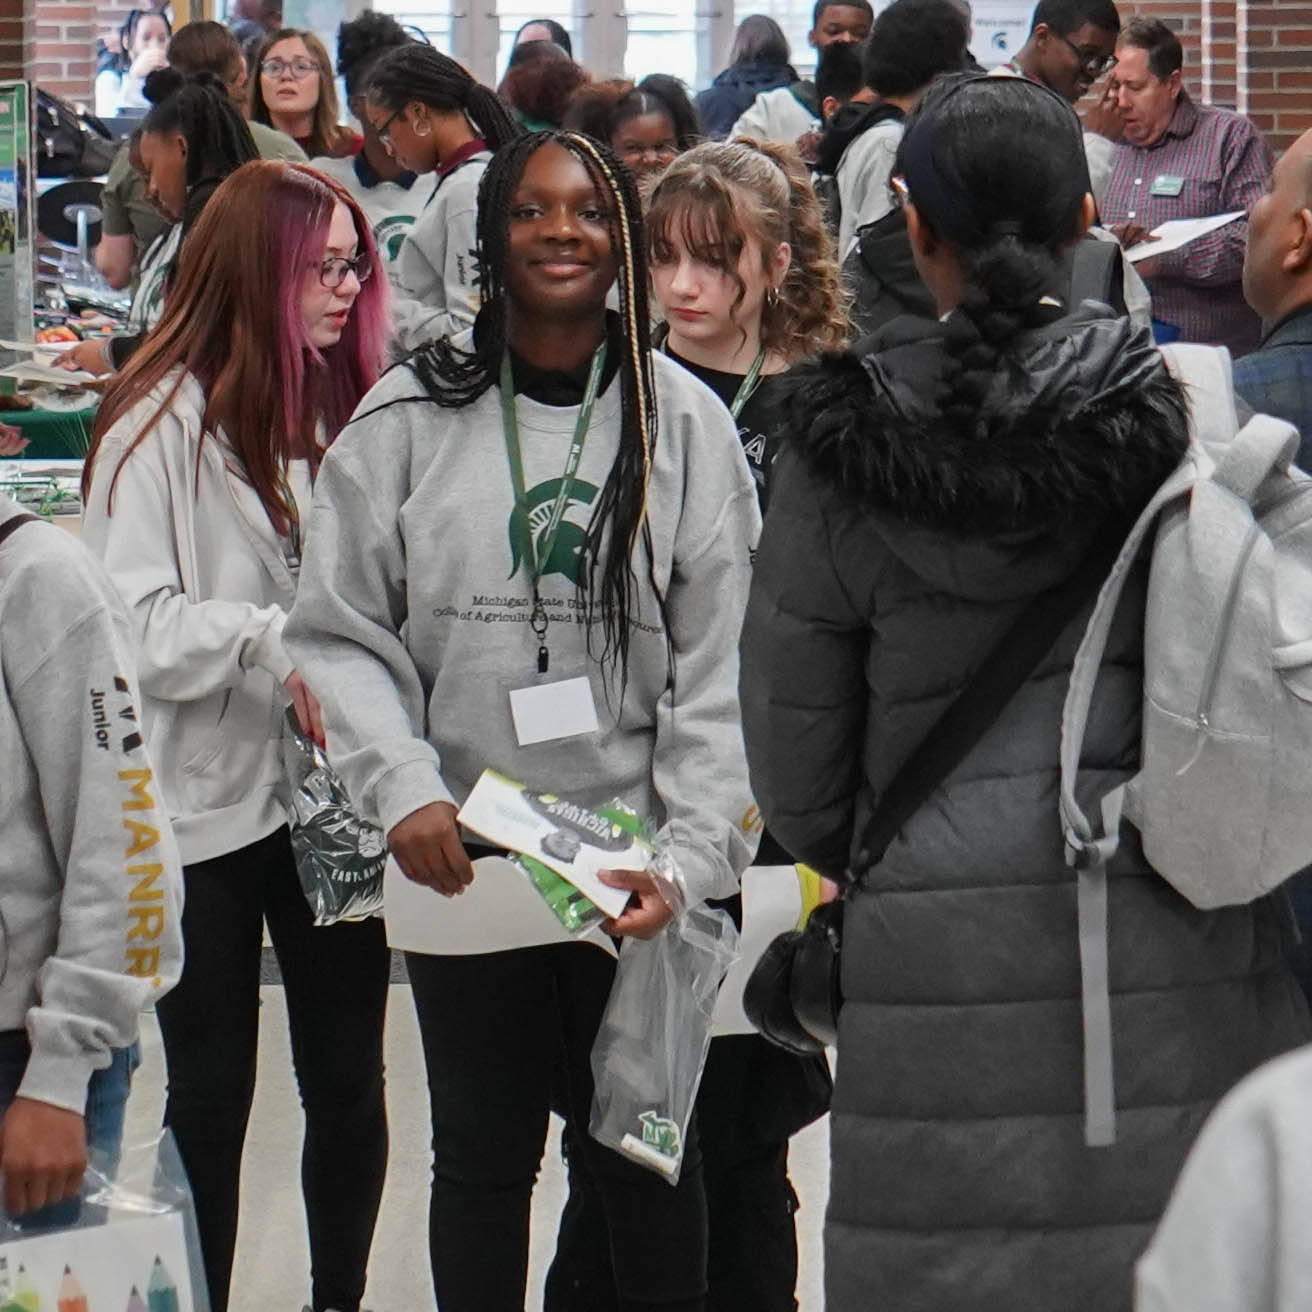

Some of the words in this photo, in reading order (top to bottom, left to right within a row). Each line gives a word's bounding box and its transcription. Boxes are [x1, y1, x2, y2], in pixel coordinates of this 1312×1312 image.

[472, 595, 529, 608] Michigan
[459, 611, 472, 621] of
[549, 613, 572, 624] and
[89, 688, 110, 751] Junior
[117, 767, 165, 990] MANRR
[331, 868, 359, 883] EAST
